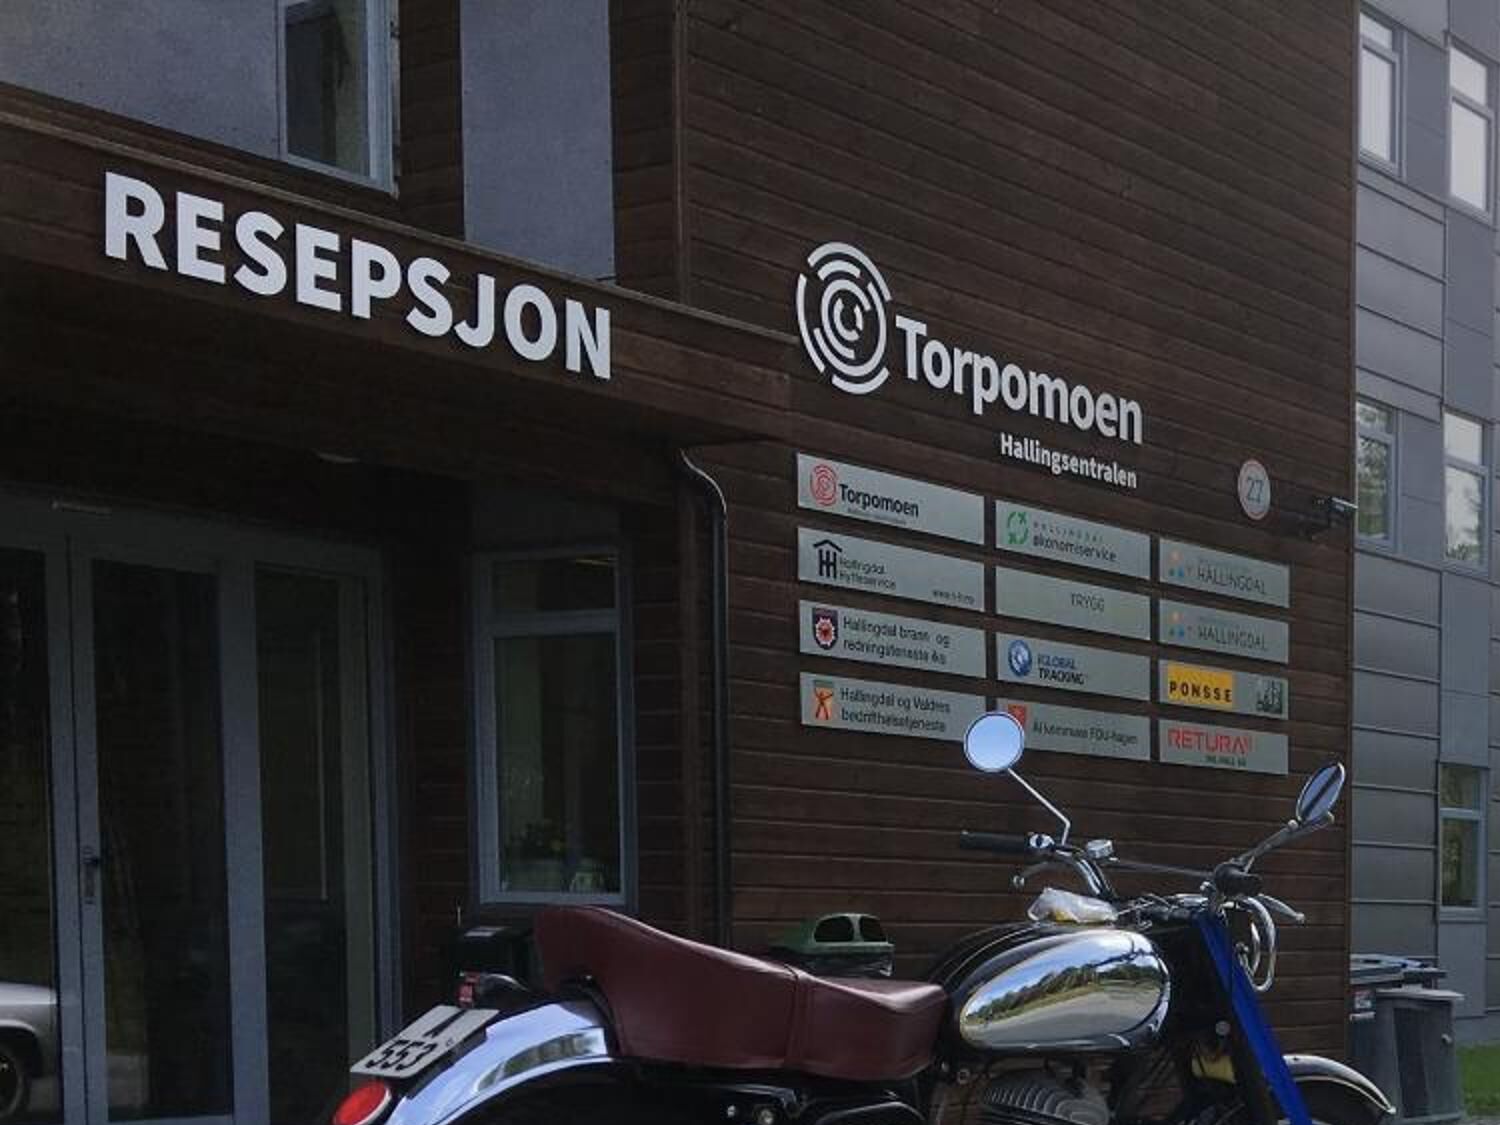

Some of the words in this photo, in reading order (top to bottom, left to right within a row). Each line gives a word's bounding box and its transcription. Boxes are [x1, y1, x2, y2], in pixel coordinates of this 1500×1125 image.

[105, 171, 611, 380] RESEPSJON
[896, 315, 1145, 444] Torpomoen
[1000, 432, 1138, 490] Hallingsentralen
[838, 483, 919, 518] Torpomoen
[843, 616, 897, 637] Hallingdal
[1039, 667, 1085, 685] TRACKING
[840, 686, 895, 709] Hallingdal
[897, 698, 912, 712] og
[1169, 680, 1233, 703] PONSSE
[1168, 729, 1249, 755] RETURA
[365, 1039, 437, 1070] 553
